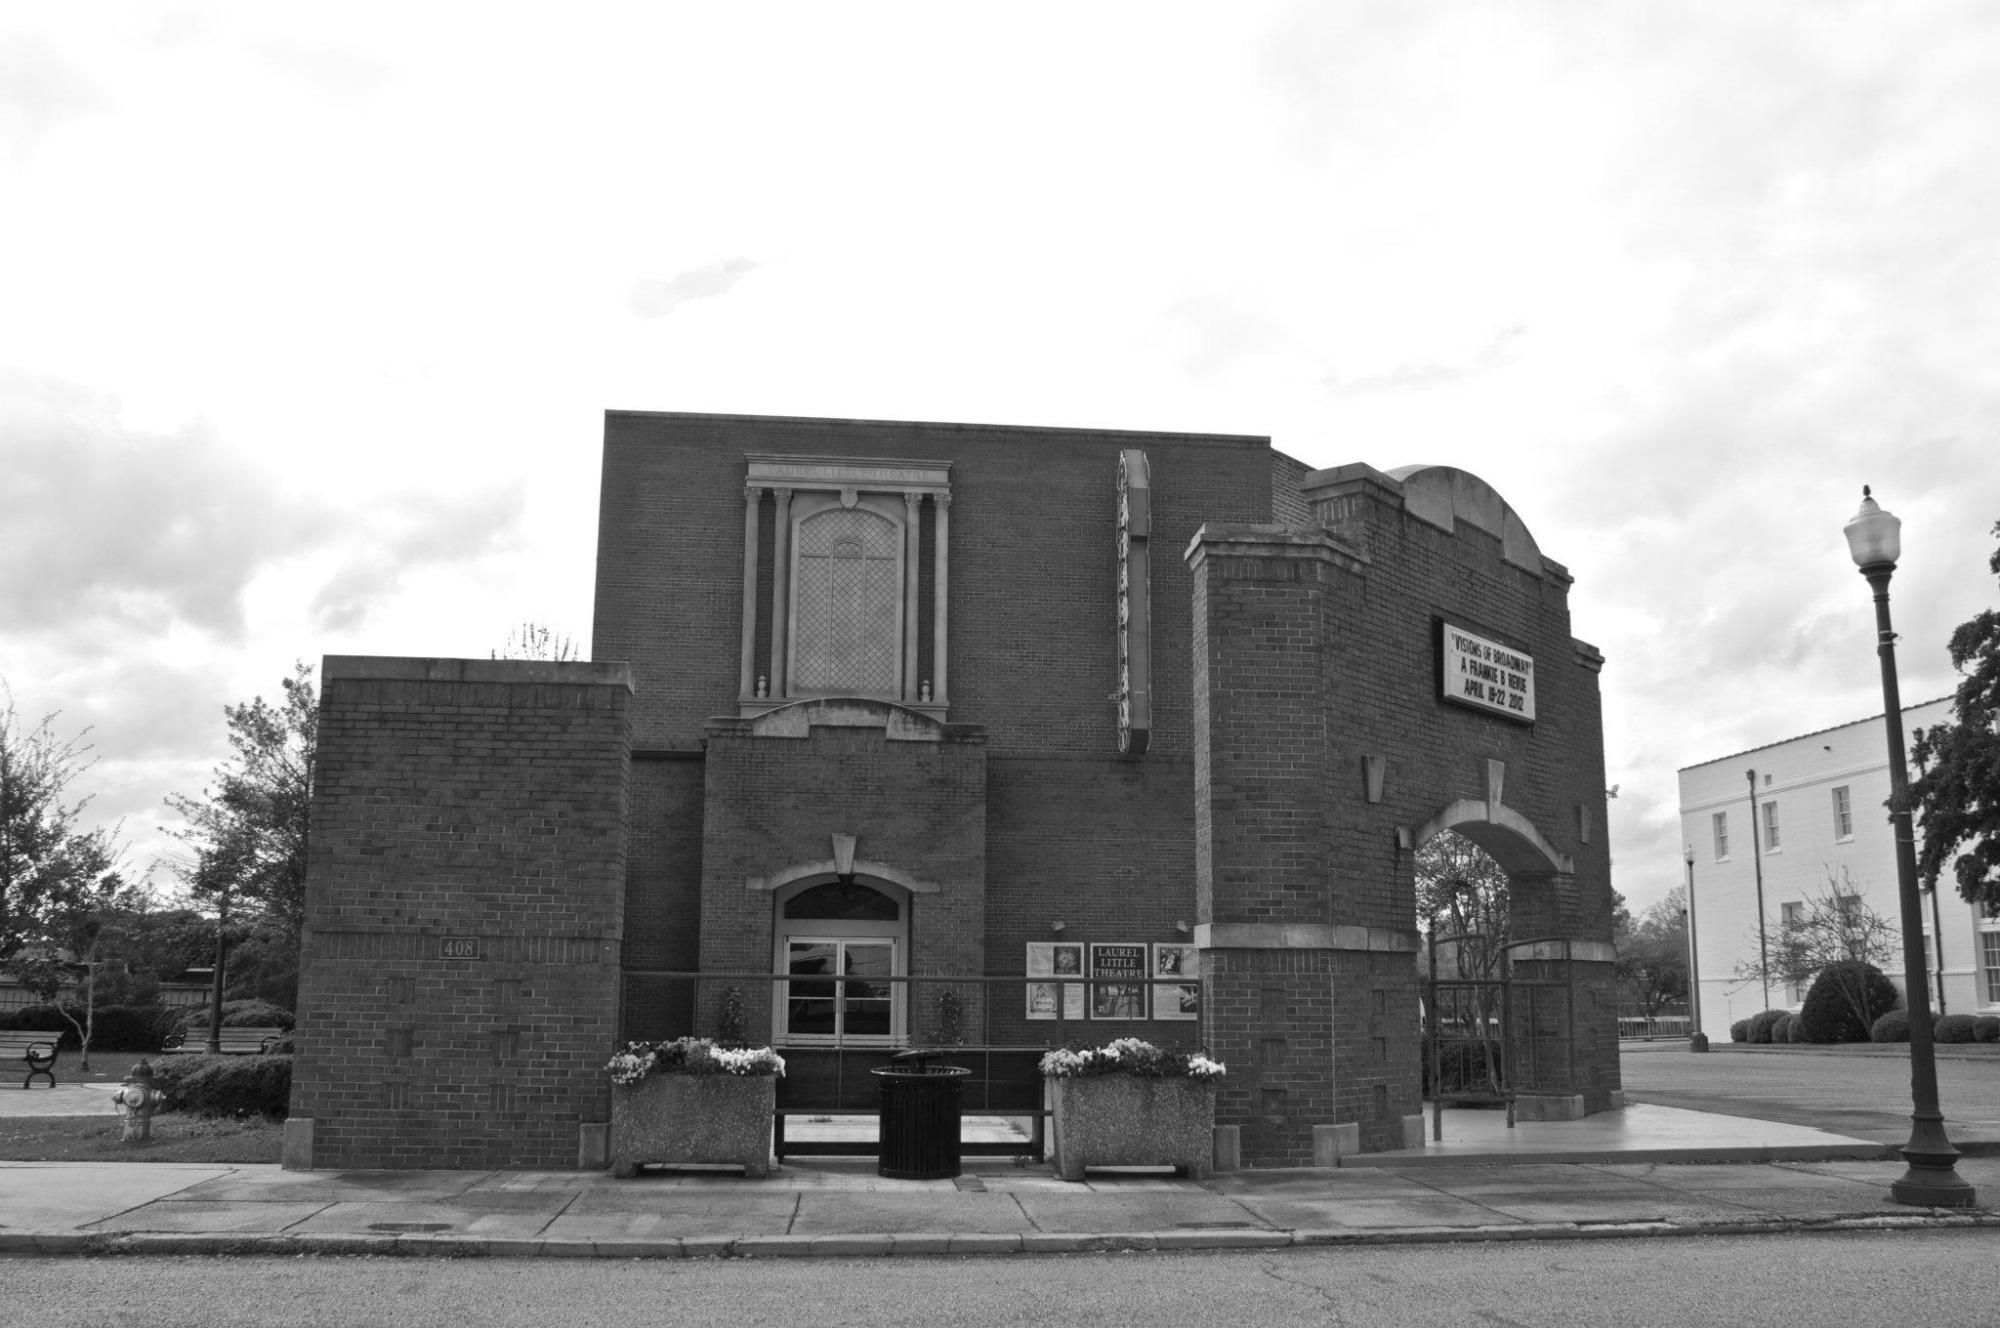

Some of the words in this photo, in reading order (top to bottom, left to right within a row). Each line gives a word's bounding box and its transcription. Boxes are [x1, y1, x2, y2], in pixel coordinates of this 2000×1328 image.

[1483, 646, 1491, 662] OF
[1461, 656, 1467, 673] A
[1470, 660, 1498, 684] FRANKIE
[1500, 670, 1506, 686] B
[1507, 673, 1527, 694] REVUE
[1464, 679, 1484, 699] APRIL
[1488, 685, 1506, 706] 19-22
[1508, 693, 1524, 712] 2012
[445, 940, 473, 956] 408
[1098, 948, 1139, 957] LAUREL
[1100, 958, 1136, 968] LITTLE
[1094, 968, 1143, 978] THEATRE
